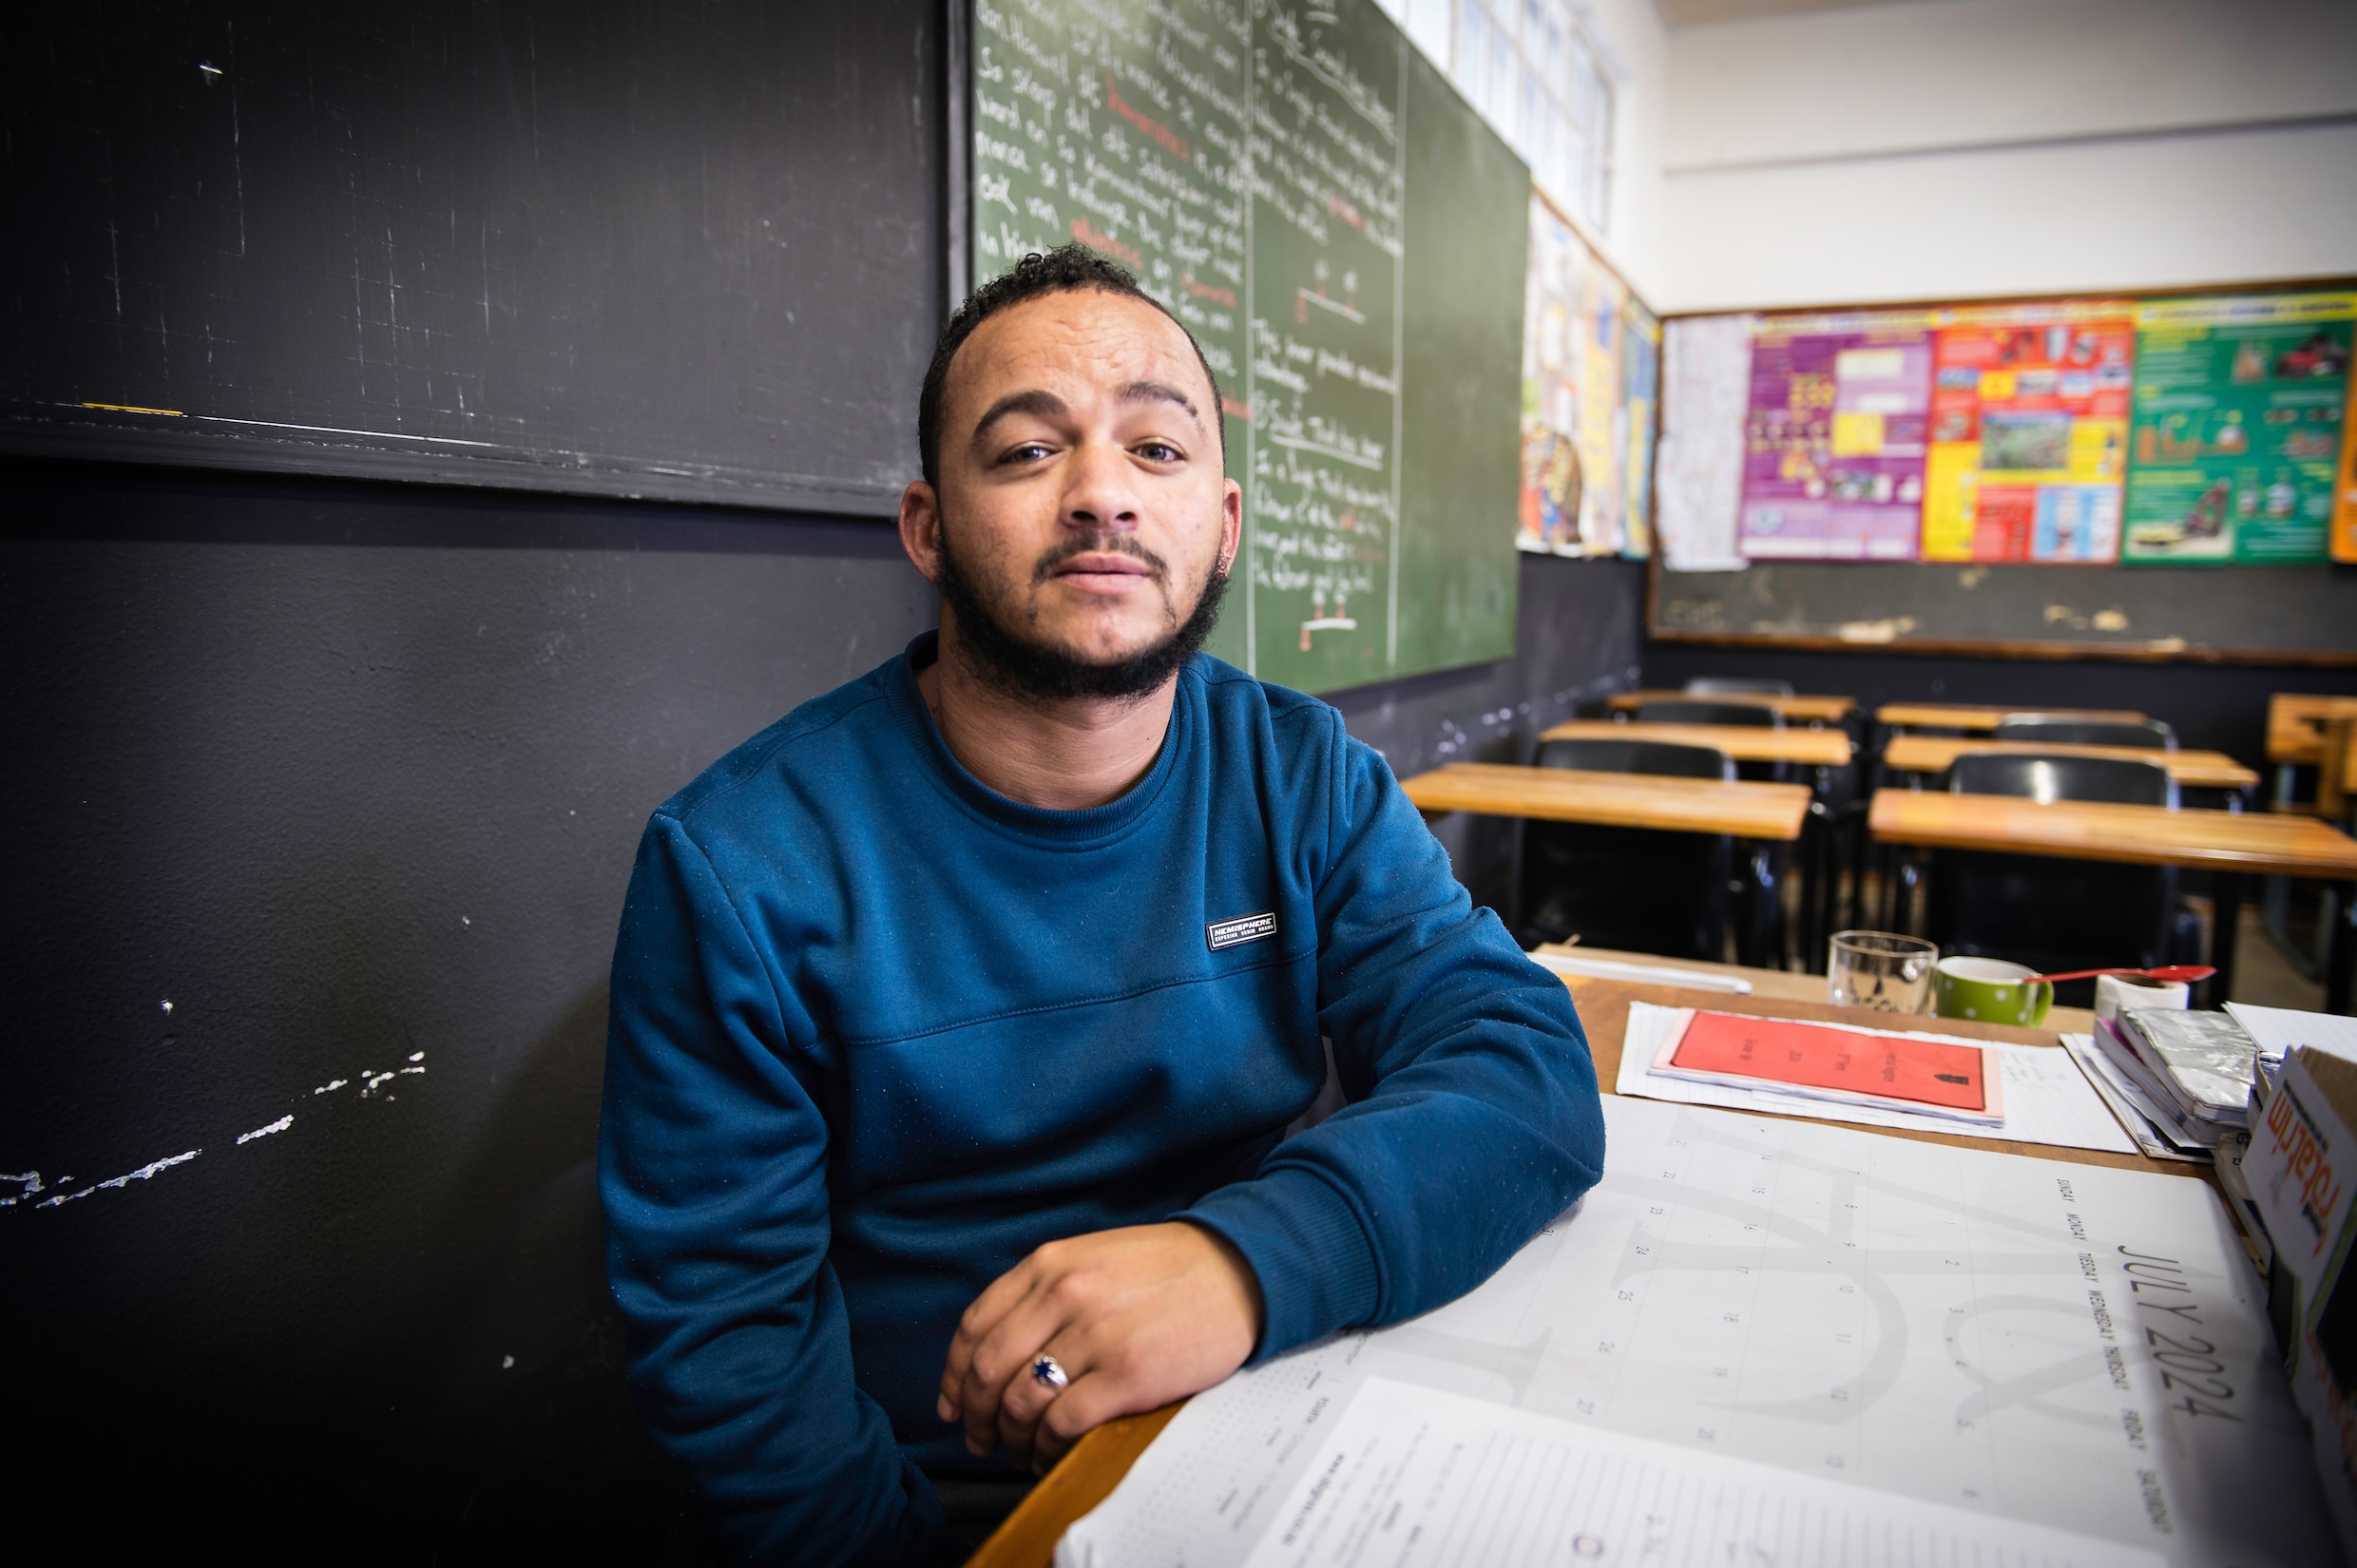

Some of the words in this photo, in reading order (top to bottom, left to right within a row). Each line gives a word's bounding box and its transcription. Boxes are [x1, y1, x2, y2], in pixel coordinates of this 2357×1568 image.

[1214, 918, 1273, 937] HEMISPHERE
[1663, 1171, 1677, 1179] 22
[2057, 1178, 2076, 1203] SUNDAY
[1649, 1206, 1664, 1215] 23
[1743, 1223, 1757, 1232] 16
[2066, 1213, 2087, 1241] MONDAY
[1635, 1245, 1650, 1256] 24
[1734, 1265, 1750, 1274] 17
[1838, 1284, 1853, 1293] 10
[2117, 1245, 2204, 1324] JULY
[1618, 1290, 1634, 1302] 25
[1723, 1312, 1740, 1324] 18
[2088, 1290, 2116, 1341] WEDNESDAY
[1835, 1332, 1851, 1344] 11
[1599, 1341, 1616, 1354] 26
[2103, 1346, 2131, 1391] THURSDAY
[2145, 1327, 2249, 1424] 2024
[1830, 1388, 1848, 1403] 12
[2121, 1408, 2149, 1452] FRIDAY
